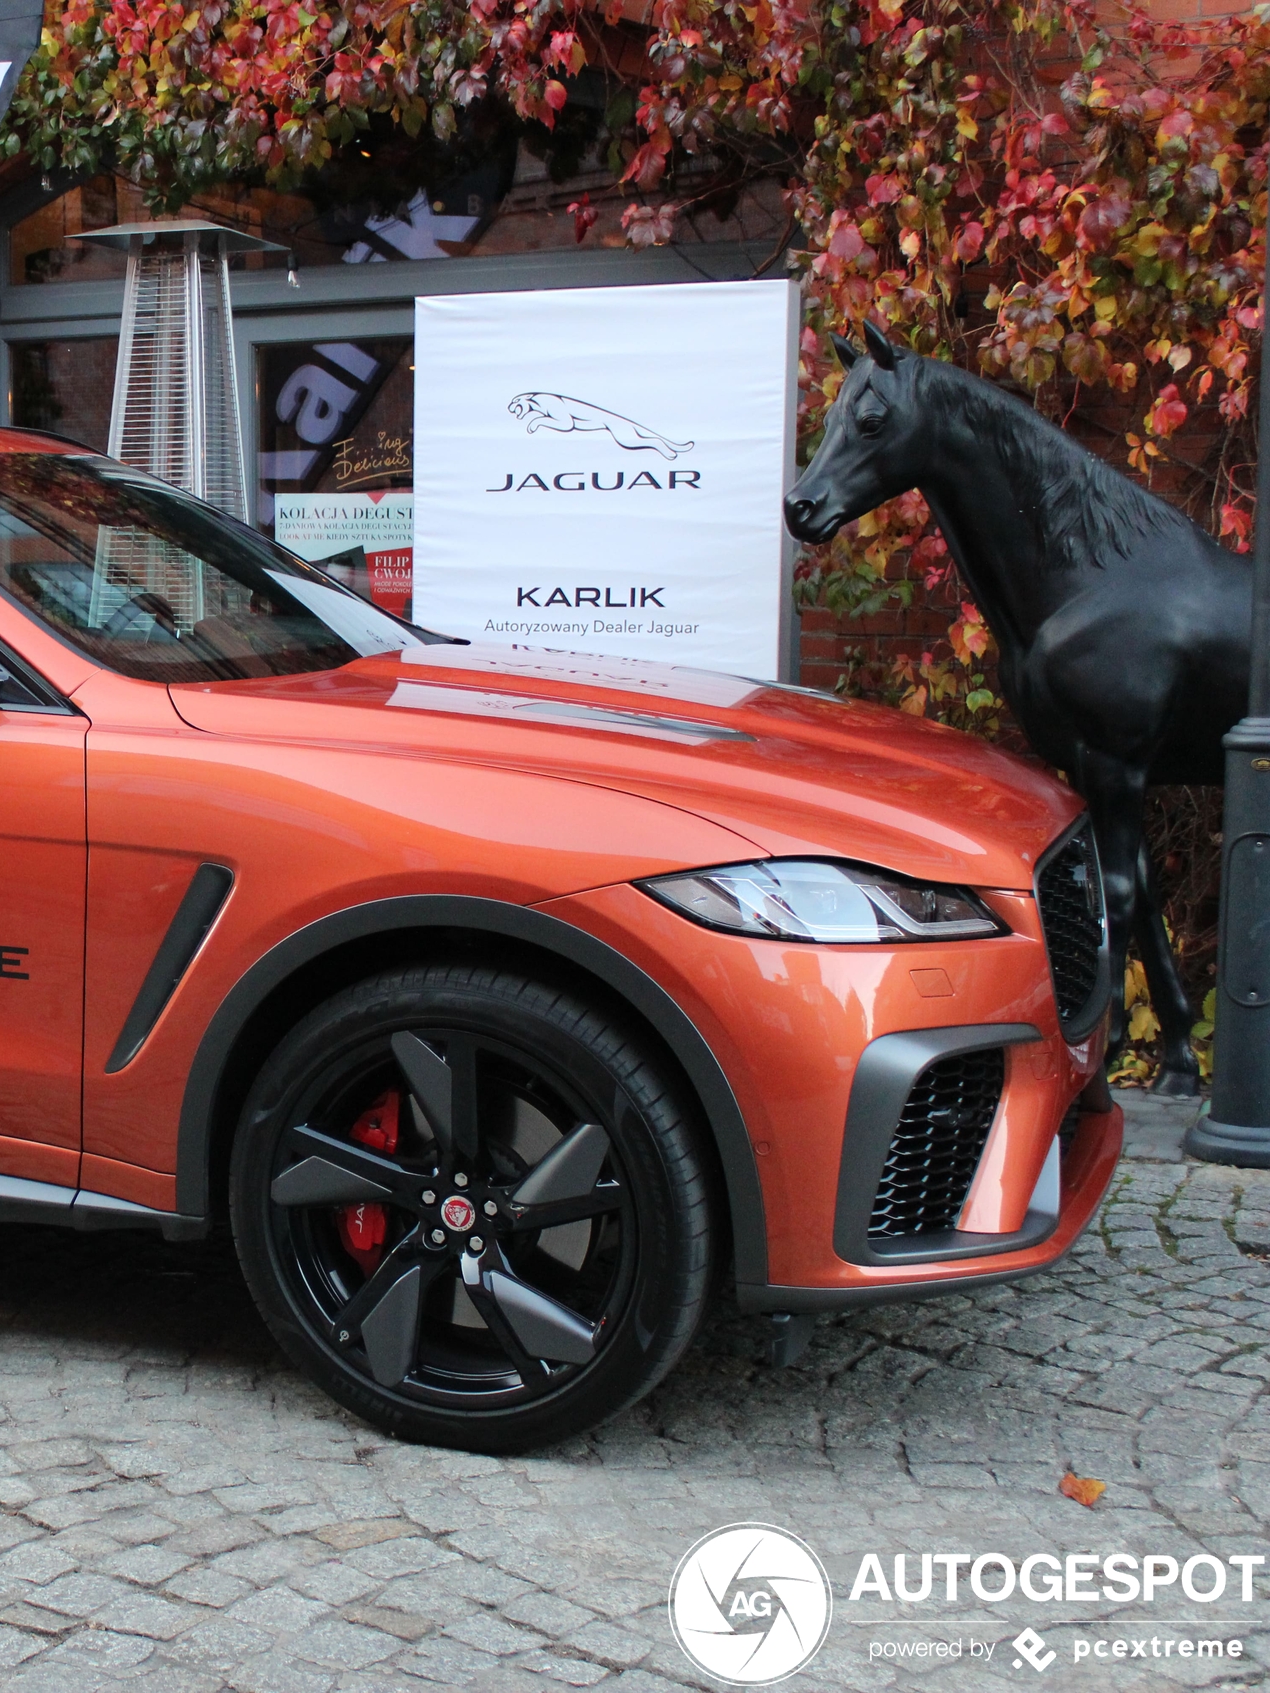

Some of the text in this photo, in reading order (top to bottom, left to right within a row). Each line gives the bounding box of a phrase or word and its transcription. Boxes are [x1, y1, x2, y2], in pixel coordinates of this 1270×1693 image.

[485, 470, 702, 492] JAGUAR
[279, 507, 348, 520] KOLACJA
[324, 522, 359, 530] KOLACJA
[361, 522, 413, 530] DEGUSTACYJ
[375, 556, 410, 567] FILIP
[516, 586, 666, 608] KARLIK
[484, 618, 700, 637] Autoryzowany Dealer Jaguar
